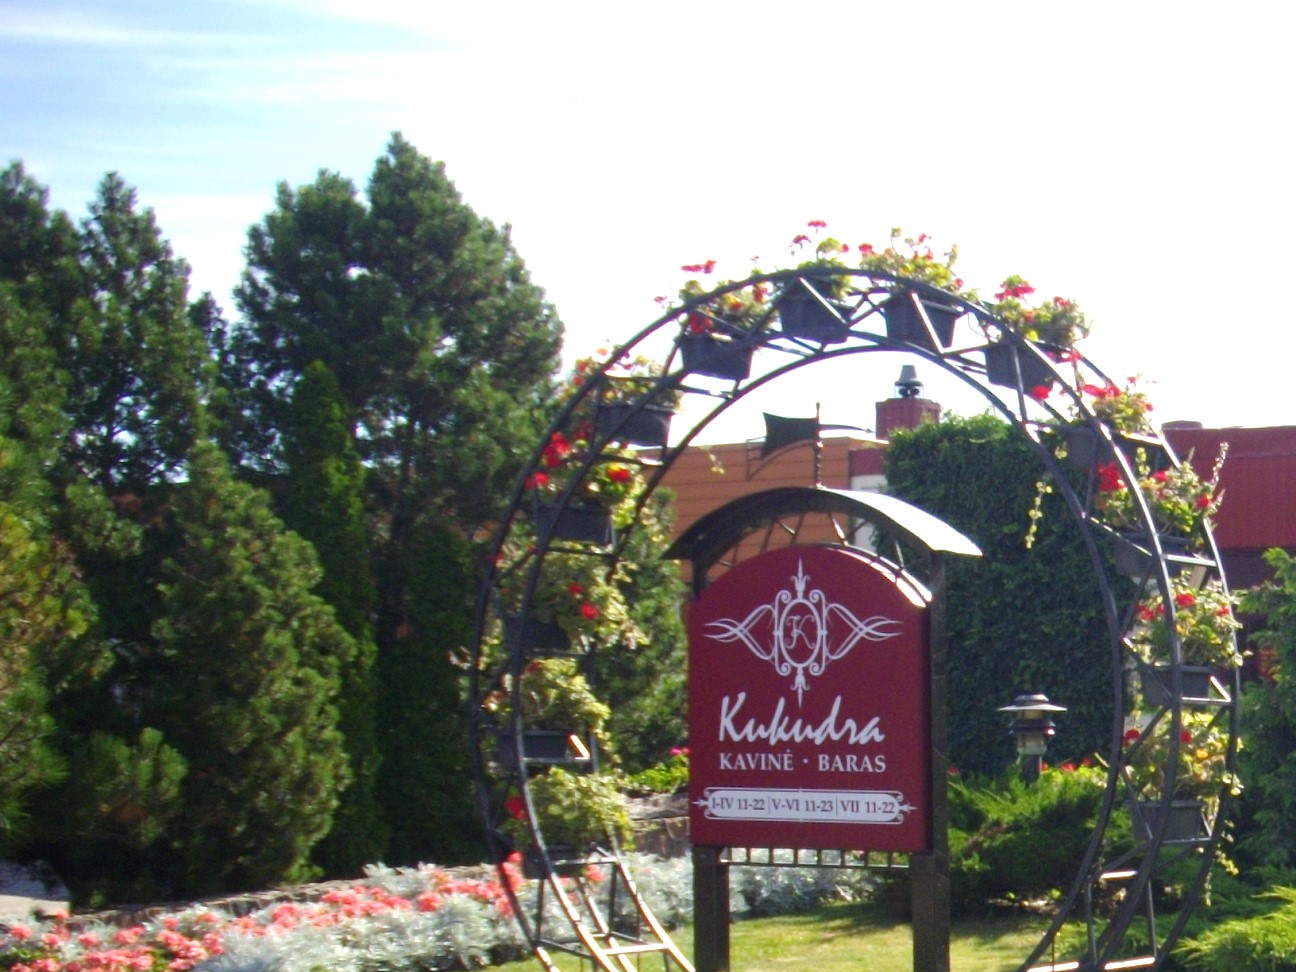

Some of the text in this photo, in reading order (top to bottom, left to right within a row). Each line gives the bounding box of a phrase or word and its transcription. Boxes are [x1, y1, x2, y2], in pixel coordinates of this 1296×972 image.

[719, 691, 886, 746] Kukudra
[719, 749, 887, 773] KAVINĖ BARAS
[711, 797, 895, 814] I-IV 11-22 V-VI 11-23 VII 11-22
